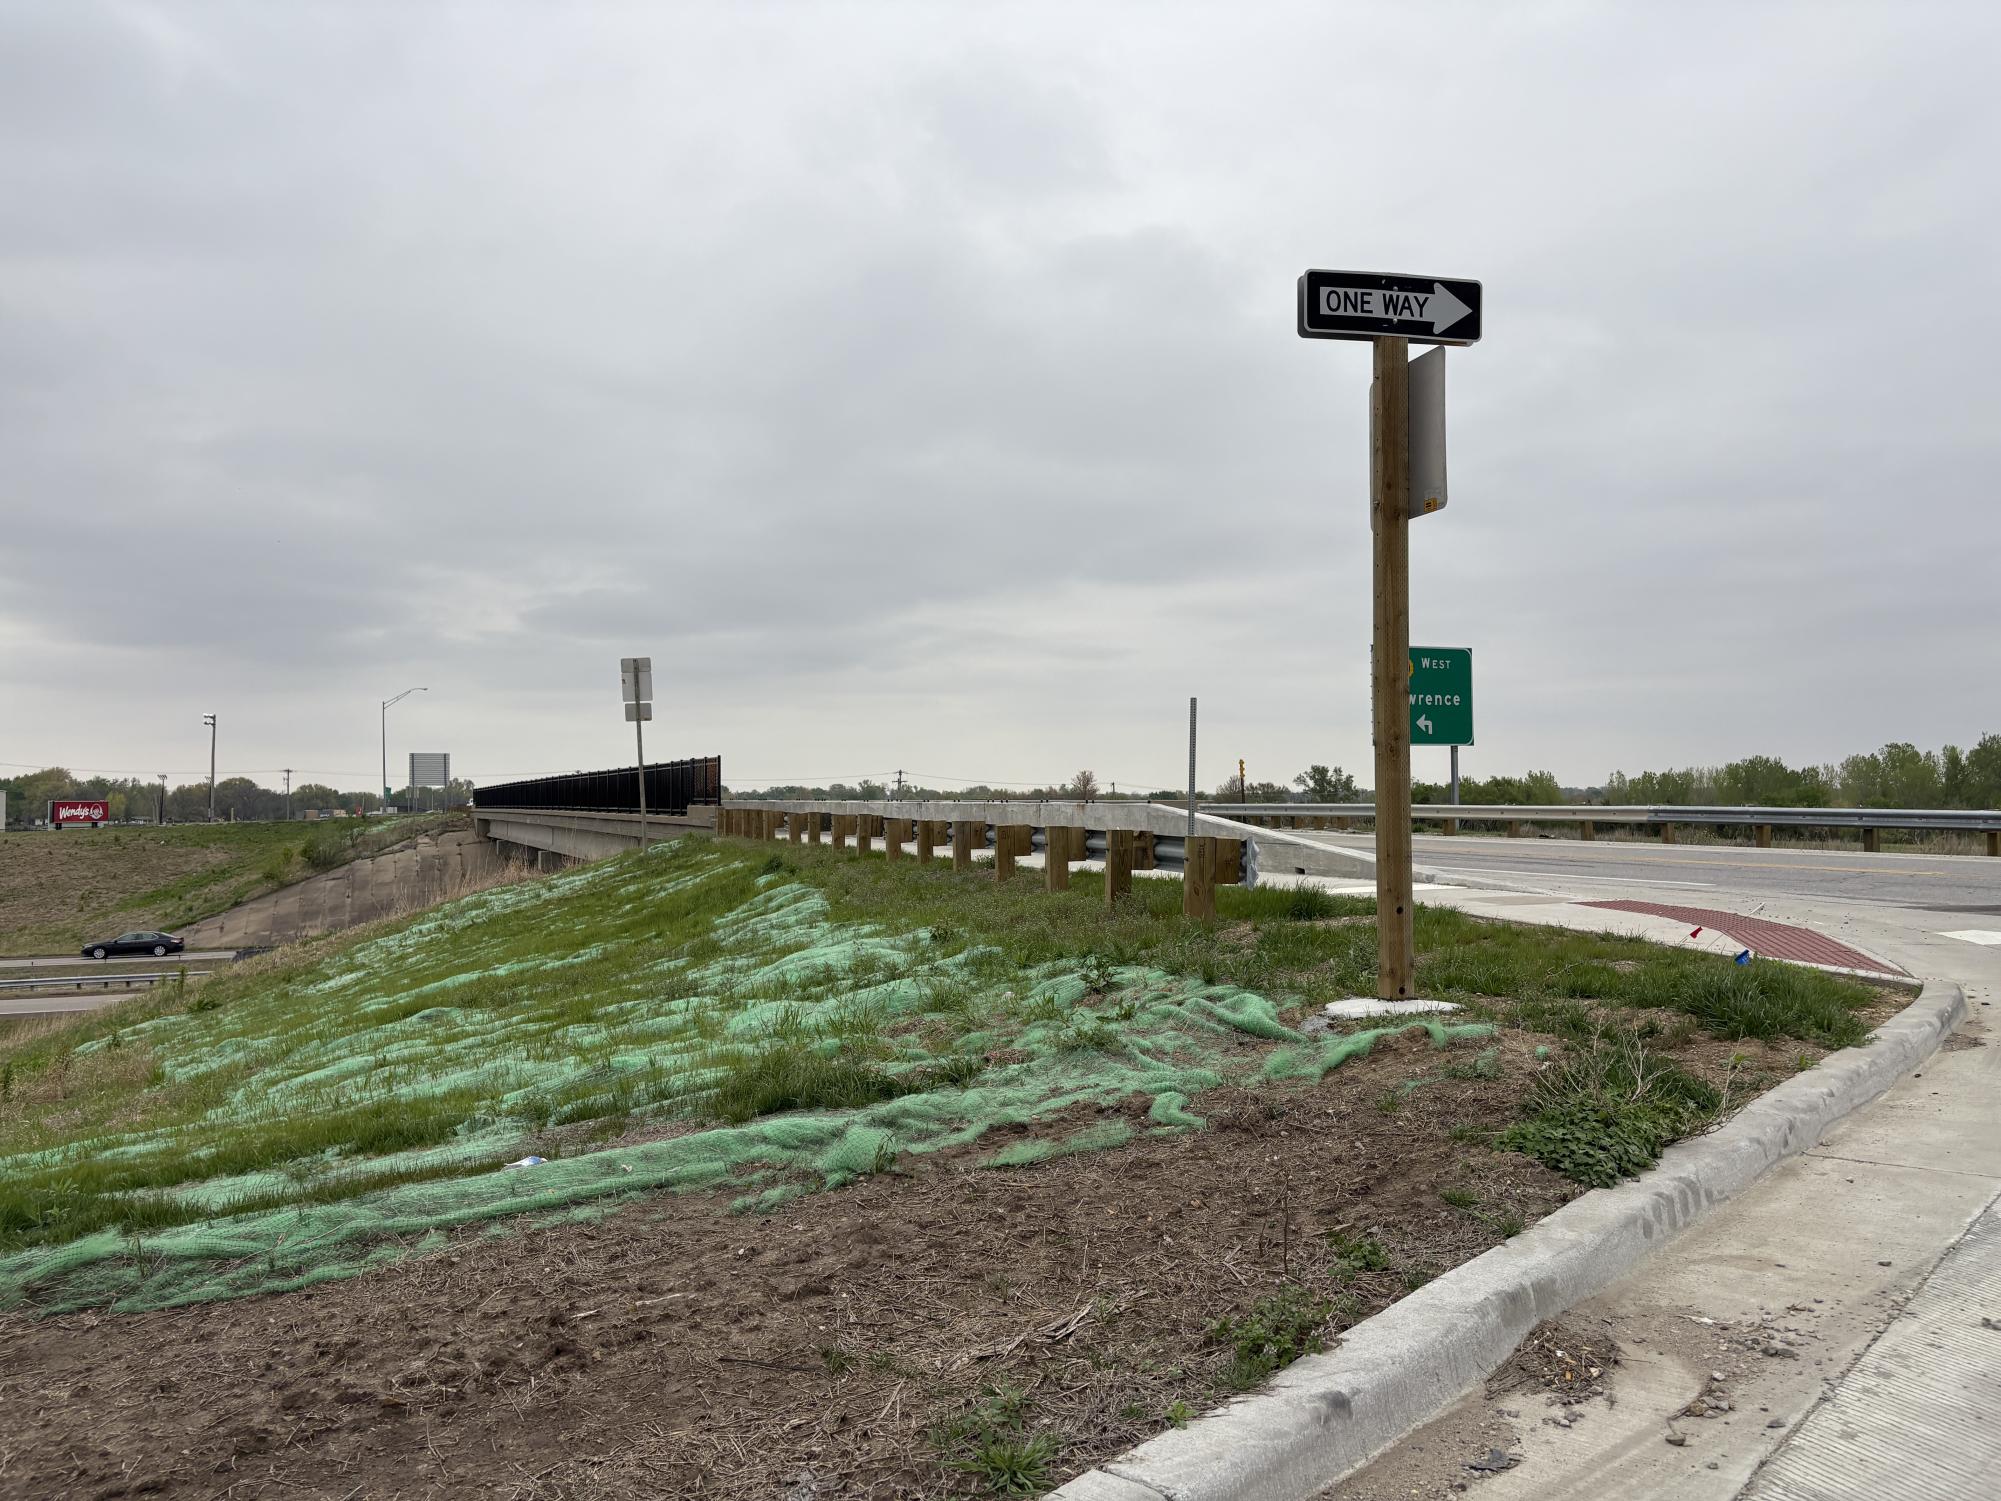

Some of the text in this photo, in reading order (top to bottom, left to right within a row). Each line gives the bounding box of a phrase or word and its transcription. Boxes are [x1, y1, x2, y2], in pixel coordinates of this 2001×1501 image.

[1326, 290, 1429, 318] ONE WAY
[1421, 657, 1451, 670] WEST
[59, 804, 89, 820] Wendy's
